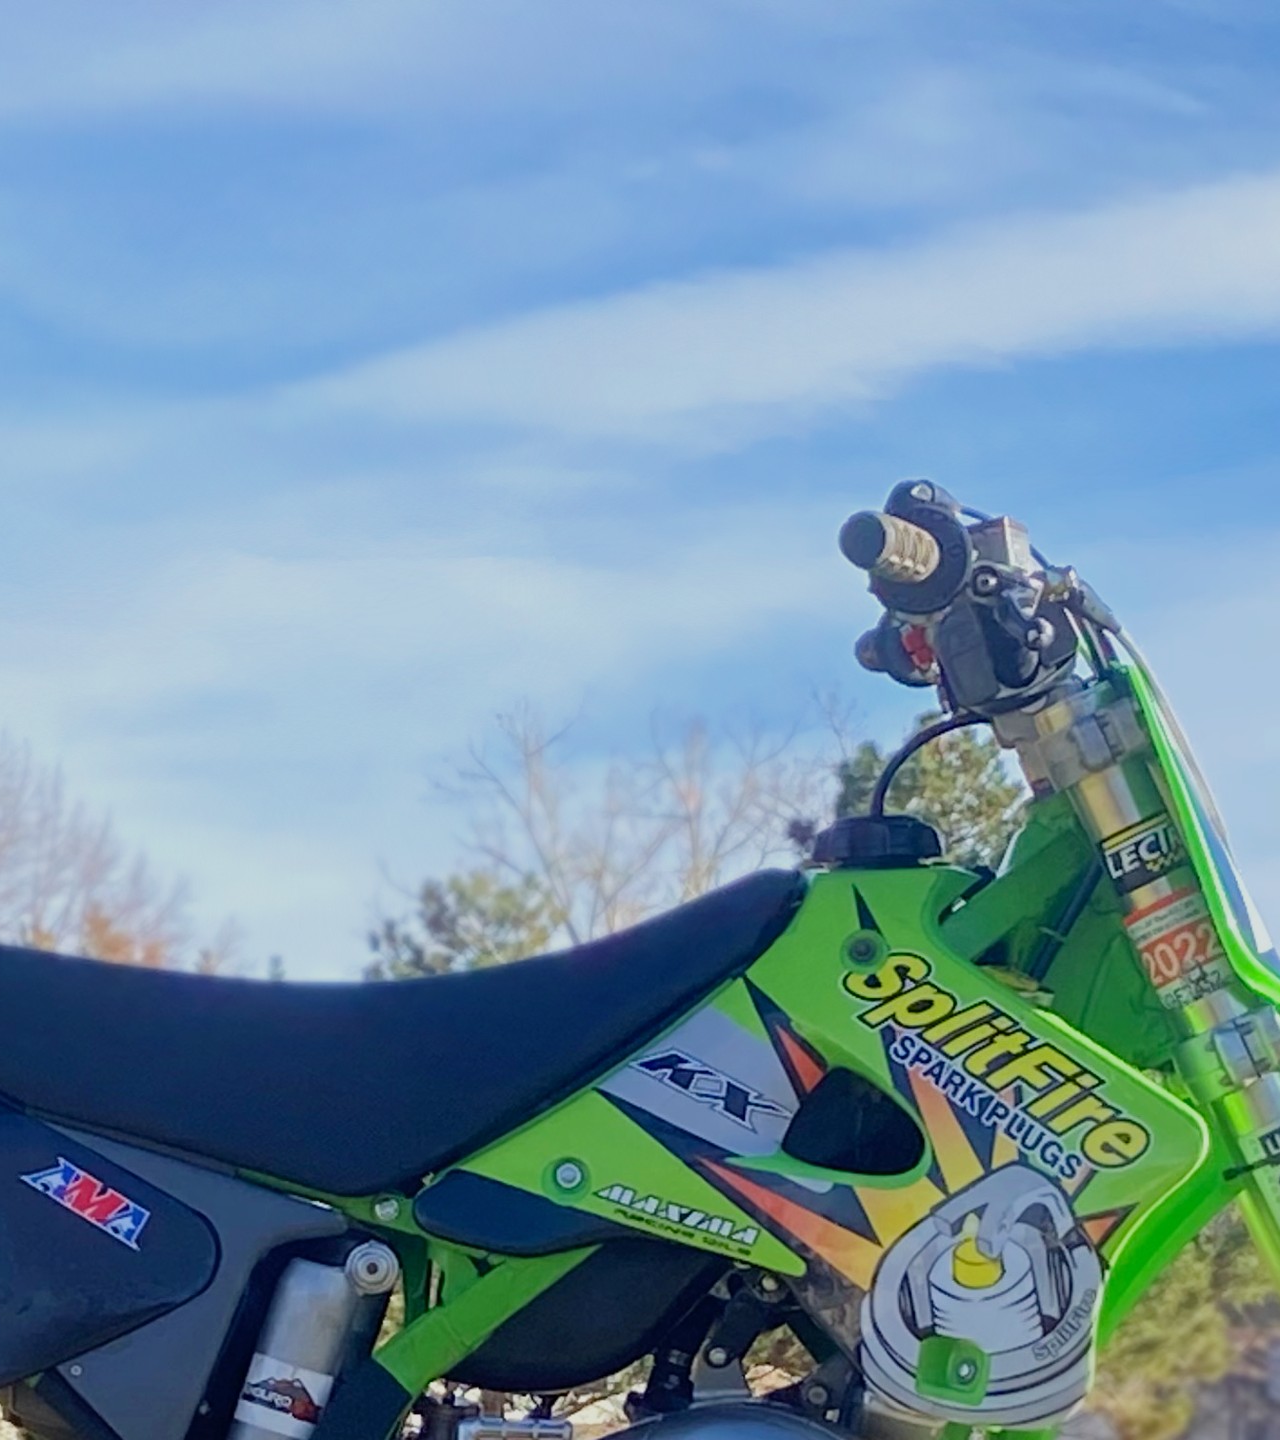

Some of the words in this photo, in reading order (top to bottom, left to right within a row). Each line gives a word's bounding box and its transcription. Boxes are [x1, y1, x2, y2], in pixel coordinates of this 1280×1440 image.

[631, 1050, 790, 1131] KX
[891, 1035, 988, 1117] SPARK
[983, 1097, 1085, 1180] PLUGS
[20, 1156, 151, 1251] AMA
[593, 1184, 761, 1246] MAXIMA
